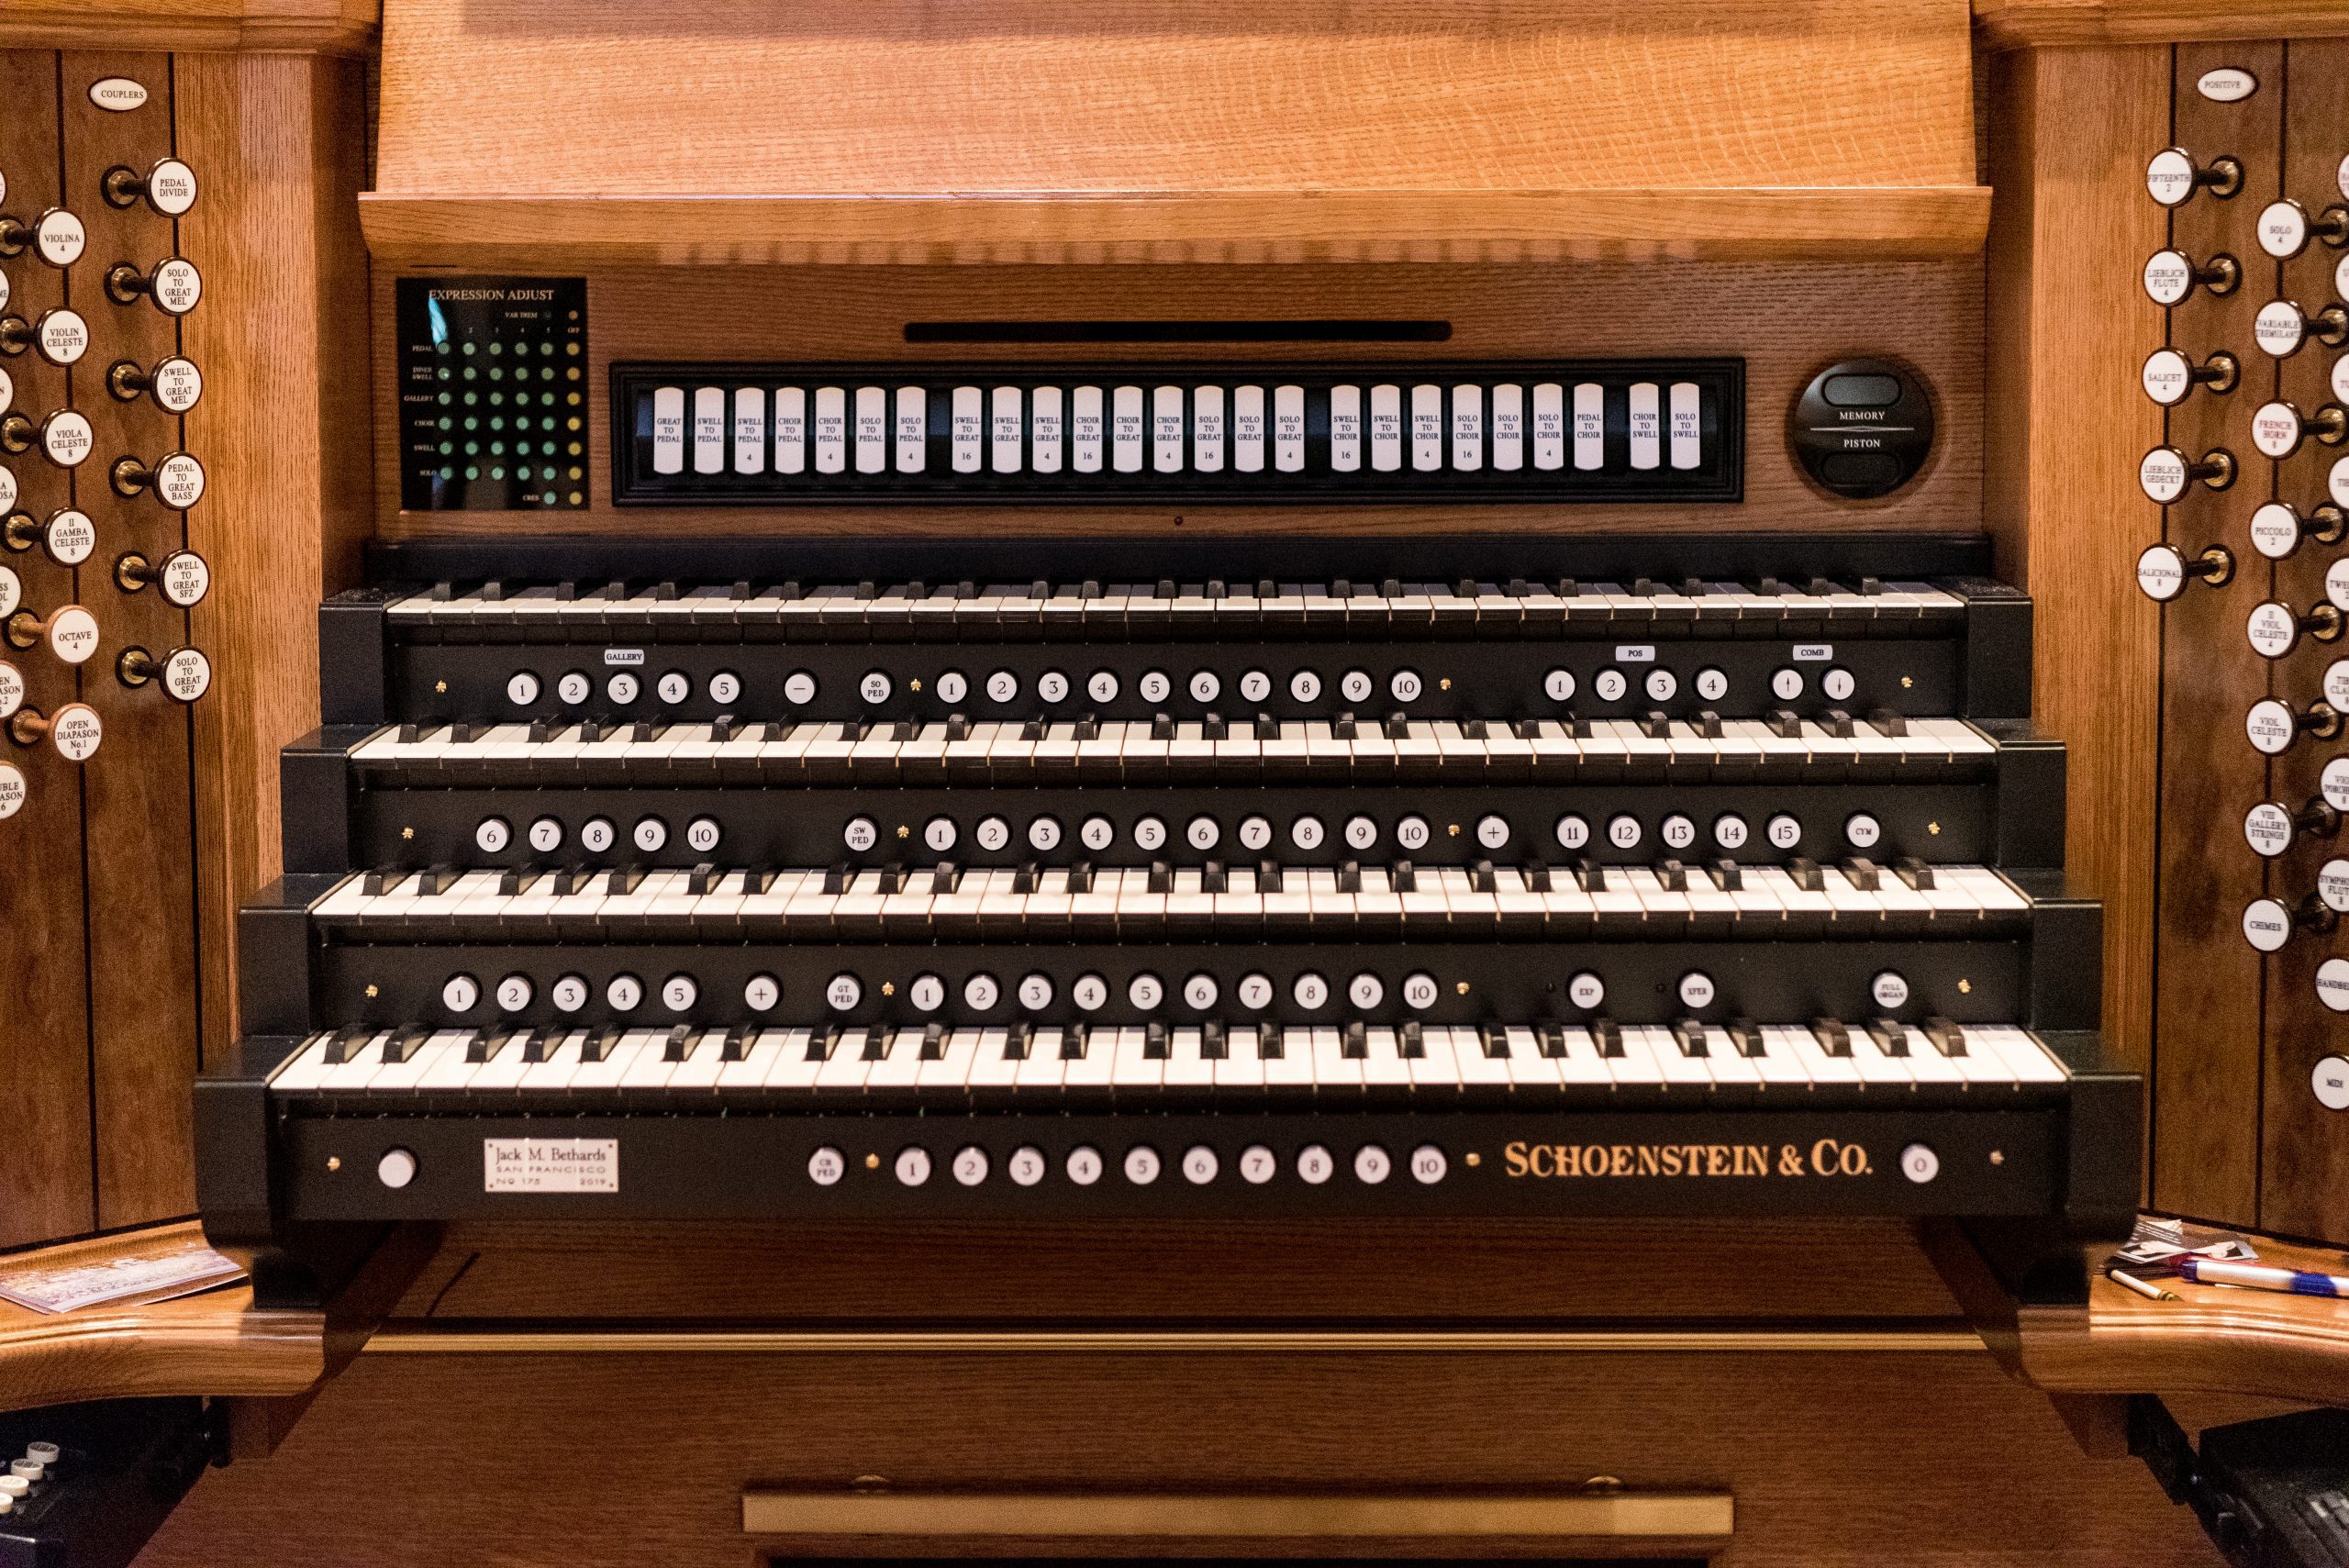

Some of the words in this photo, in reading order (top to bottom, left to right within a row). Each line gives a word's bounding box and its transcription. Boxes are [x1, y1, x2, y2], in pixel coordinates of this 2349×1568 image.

[2204, 80, 2242, 90] POSITIVE
[100, 89, 144, 99] COUPLERS
[159, 178, 187, 188] PEDAL
[159, 187, 189, 197] DIVIDE
[2269, 225, 2292, 235] SOLO
[43, 233, 80, 243] VIOLINA
[60, 243, 66, 252] 4
[166, 268, 189, 278] SOLO
[2147, 268, 2186, 278] LIEBLICH
[173, 278, 184, 287] TO
[2153, 278, 2179, 288] FLUTE
[164, 287, 192, 297] GREAT
[429, 289, 505, 301] EXPRESSION
[507, 289, 554, 301] ADJUST
[170, 296, 187, 306] MEL
[49, 328, 80, 338] VIOLIN
[47, 337, 83, 348] CELESTE
[62, 347, 69, 357] 8
[163, 367, 192, 377] SWELL
[173, 376, 184, 386] TO
[2147, 373, 2183, 383] SALICET
[165, 385, 193, 396] GREAT
[171, 395, 189, 405] MEL
[954, 416, 980, 425] SWELL
[1075, 416, 1100, 425] CHOIR
[1333, 415, 1359, 424] SWELL
[1456, 414, 1479, 423] SOLO
[1576, 413, 1601, 422] PEDAL
[1675, 412, 1697, 421] SOLO
[1839, 411, 1886, 421] MEMORY
[656, 417, 682, 426] GREAT
[737, 417, 763, 426] SWELL
[1583, 422, 1595, 430] TO
[1679, 421, 1692, 430] TO
[662, 426, 675, 435] TO
[744, 426, 756, 435] TO
[962, 425, 973, 433] TO
[1082, 425, 1094, 433] TO
[1340, 424, 1352, 432] TO
[1462, 423, 1474, 432] TO
[55, 428, 83, 439] VIOLA
[656, 434, 682, 443] PEDAL
[954, 433, 980, 442] GREAT
[1075, 433, 1100, 442] GREAT
[1333, 432, 1358, 441] CHOIR
[1455, 431, 1480, 440] CHOIR
[1576, 430, 1601, 439] CHOIR
[1673, 429, 1698, 439] SWELL
[51, 437, 88, 450] CELESTE
[737, 435, 763, 443] PEDAL
[1843, 439, 1881, 448] PISTON
[67, 449, 73, 459] 8
[962, 451, 972, 461] 16
[1083, 451, 1093, 461] 16
[1341, 450, 1352, 460] 16
[1463, 450, 1473, 459] 16
[167, 463, 195, 473] PEDAL
[175, 473, 187, 483] TO
[167, 482, 195, 492] GREAT
[170, 490, 193, 501] BASS
[68, 517, 75, 528] II
[55, 528, 88, 538] GAMBA
[2254, 526, 2292, 537] PICCOLO
[54, 536, 90, 548] CELESTE
[70, 547, 76, 557] 8
[172, 561, 200, 572] SWELL
[180, 571, 193, 580] TO
[173, 579, 200, 590] GREAT
[179, 588, 195, 599] SFZ
[58, 630, 93, 642] OCTAVE
[72, 641, 79, 651] 4
[606, 652, 642, 662] GALLERY
[1627, 649, 1643, 658] POS
[1800, 649, 1825, 657] COMB
[175, 656, 198, 667] SOLO
[182, 665, 194, 675] TO
[173, 674, 202, 686] GREAT
[870, 680, 882, 688] SO
[1706, 678, 1717, 692] 4
[180, 685, 196, 695] SFZ
[519, 684, 526, 697] 1
[568, 682, 579, 696] 2
[618, 682, 629, 696] 3
[667, 682, 677, 695] 4
[719, 681, 729, 695] 5
[949, 682, 955, 695] 1
[996, 680, 1008, 695] 2
[1049, 680, 1059, 695] 3
[1097, 681, 1108, 695] 4
[1150, 680, 1160, 695] 5
[1199, 681, 1210, 695] 6
[1250, 679, 1261, 694] 7
[1301, 680, 1311, 695] 8
[1352, 680, 1363, 694] 9
[1397, 680, 1416, 694] 10
[1557, 680, 1563, 694] 1
[1607, 678, 1617, 693] 2
[1656, 679, 1667, 693] 3
[867, 689, 885, 697] PED
[66, 719, 89, 729] OPEN
[56, 728, 99, 740] DIAPASON
[70, 739, 87, 750] No.1
[75, 749, 82, 759] 8
[540, 828, 551, 843] 7
[592, 828, 603, 843] 8
[644, 828, 655, 843] 9
[695, 828, 713, 843] 10
[853, 827, 866, 835] SW
[1566, 827, 1579, 840] 11
[1617, 826, 1634, 840] 12
[1671, 825, 1687, 840] 13
[1723, 826, 1741, 840] 14
[1777, 825, 1794, 840] 15
[1854, 828, 1873, 836] CYM
[486, 829, 497, 844] 6
[852, 836, 870, 844] PED
[2248, 920, 2282, 932] CHIMES
[837, 984, 850, 994] GT
[975, 986, 987, 1002] 2
[1030, 985, 1041, 1001] 3
[1141, 985, 1152, 1001] 5
[1578, 987, 1596, 996] EXP
[834, 994, 853, 1004] PED
[924, 988, 930, 1003] 1
[1084, 987, 1095, 1002] 4
[495, 1147, 522, 1164] Jack
[529, 1147, 545, 1161] M.
[551, 1147, 607, 1162] Bethards
[1778, 1144, 1805, 1176] &
[529, 1166, 607, 1174] FRANCISCO
[579, 1177, 607, 1185] 2019
